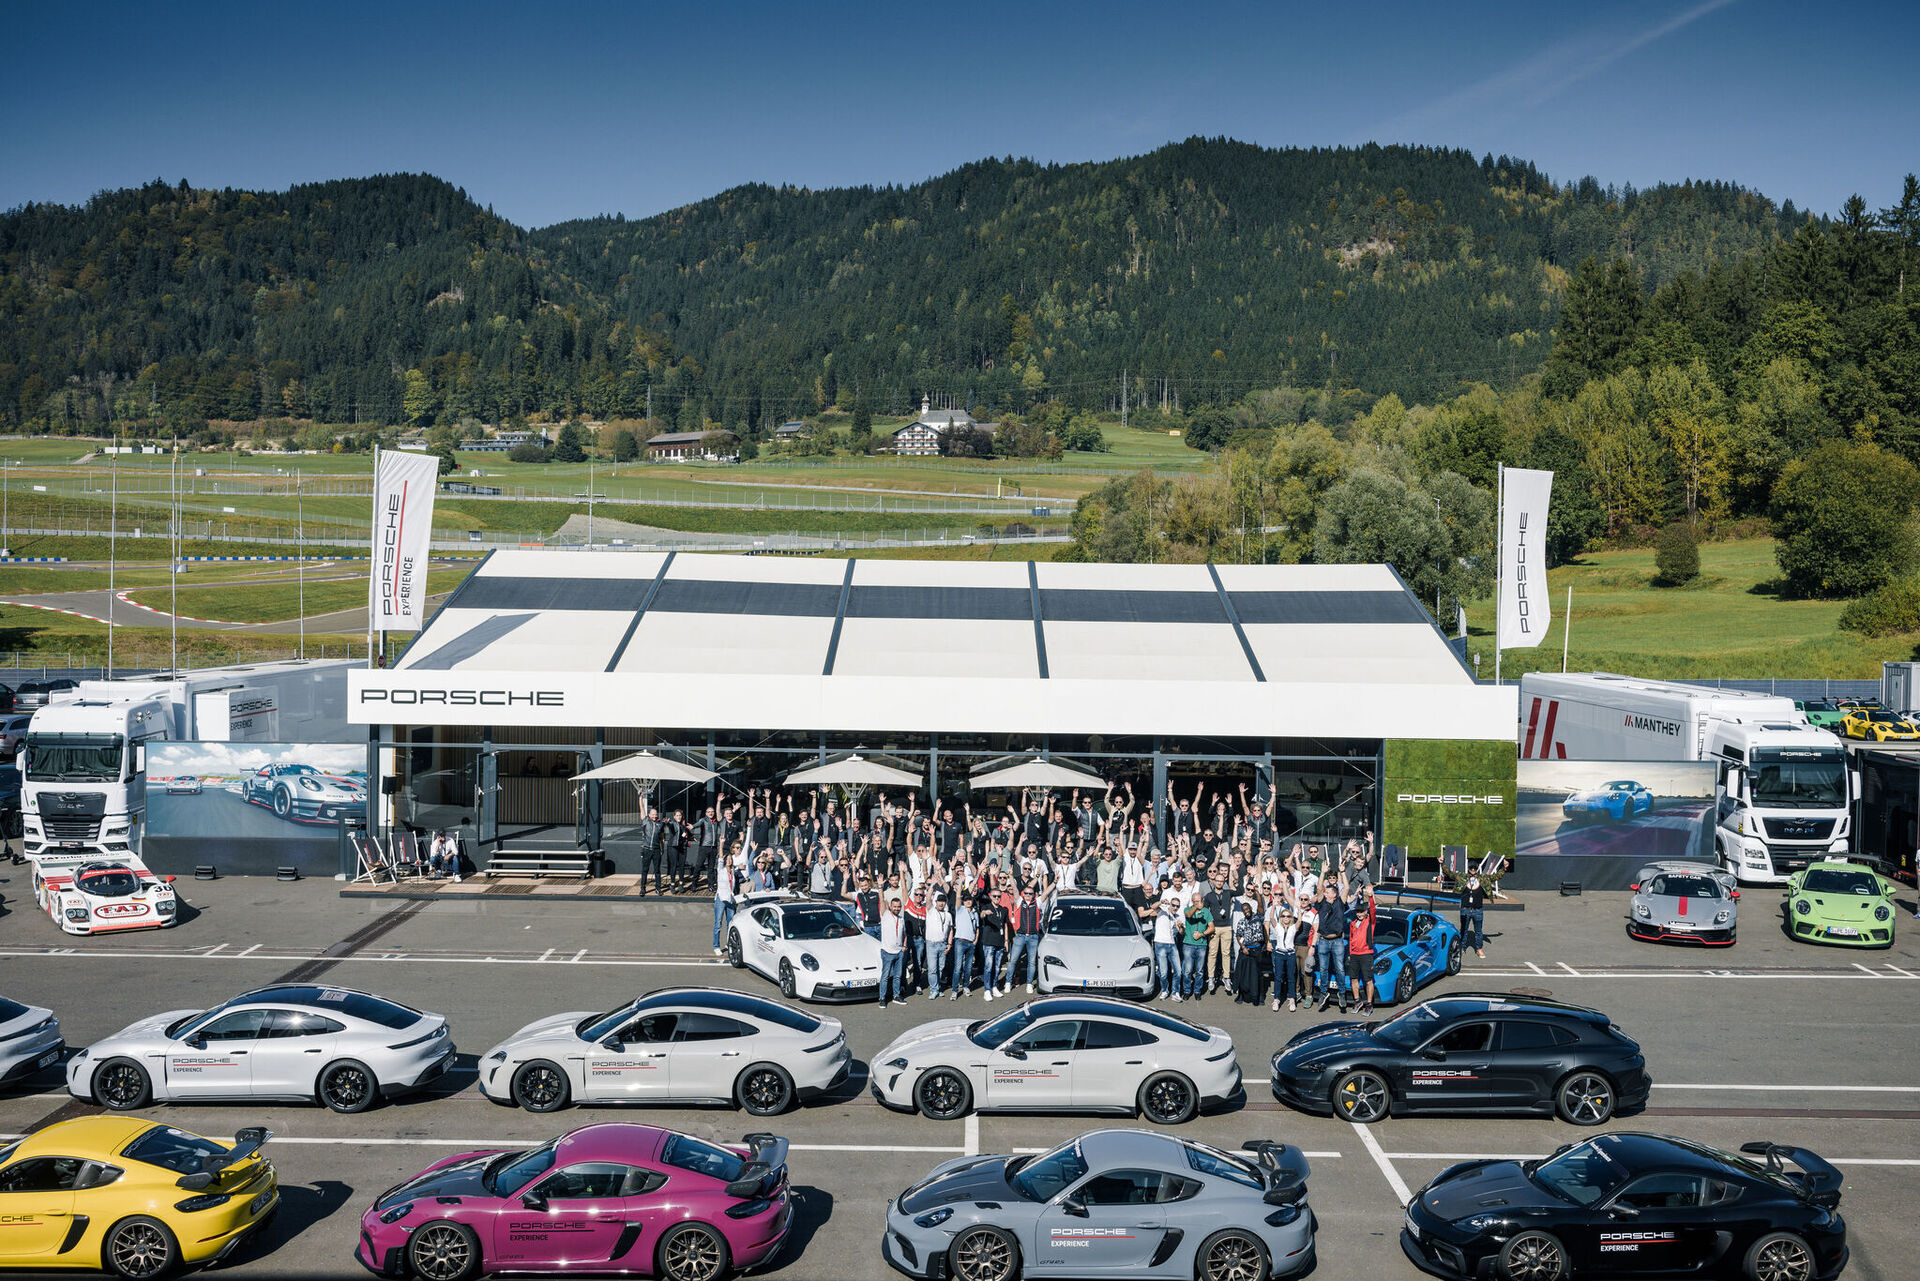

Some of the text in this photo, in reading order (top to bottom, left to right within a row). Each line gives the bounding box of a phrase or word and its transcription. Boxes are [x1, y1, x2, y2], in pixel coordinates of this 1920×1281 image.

[382, 493, 400, 616] PORSCHE
[1517, 512, 1531, 633] PORSCHE
[401, 556, 414, 616] EXPERIENCE
[361, 689, 564, 706] PORSCHE
[230, 698, 273, 713] PORSCHE
[230, 718, 253, 731] EXPERIENCE
[1635, 716, 1681, 736] MANTHEY
[1397, 794, 1503, 804] PORSCHE
[103, 905, 139, 914] FAT
[1051, 909, 1063, 920] 2
[1600, 1232, 1675, 1240] PORSCHE
